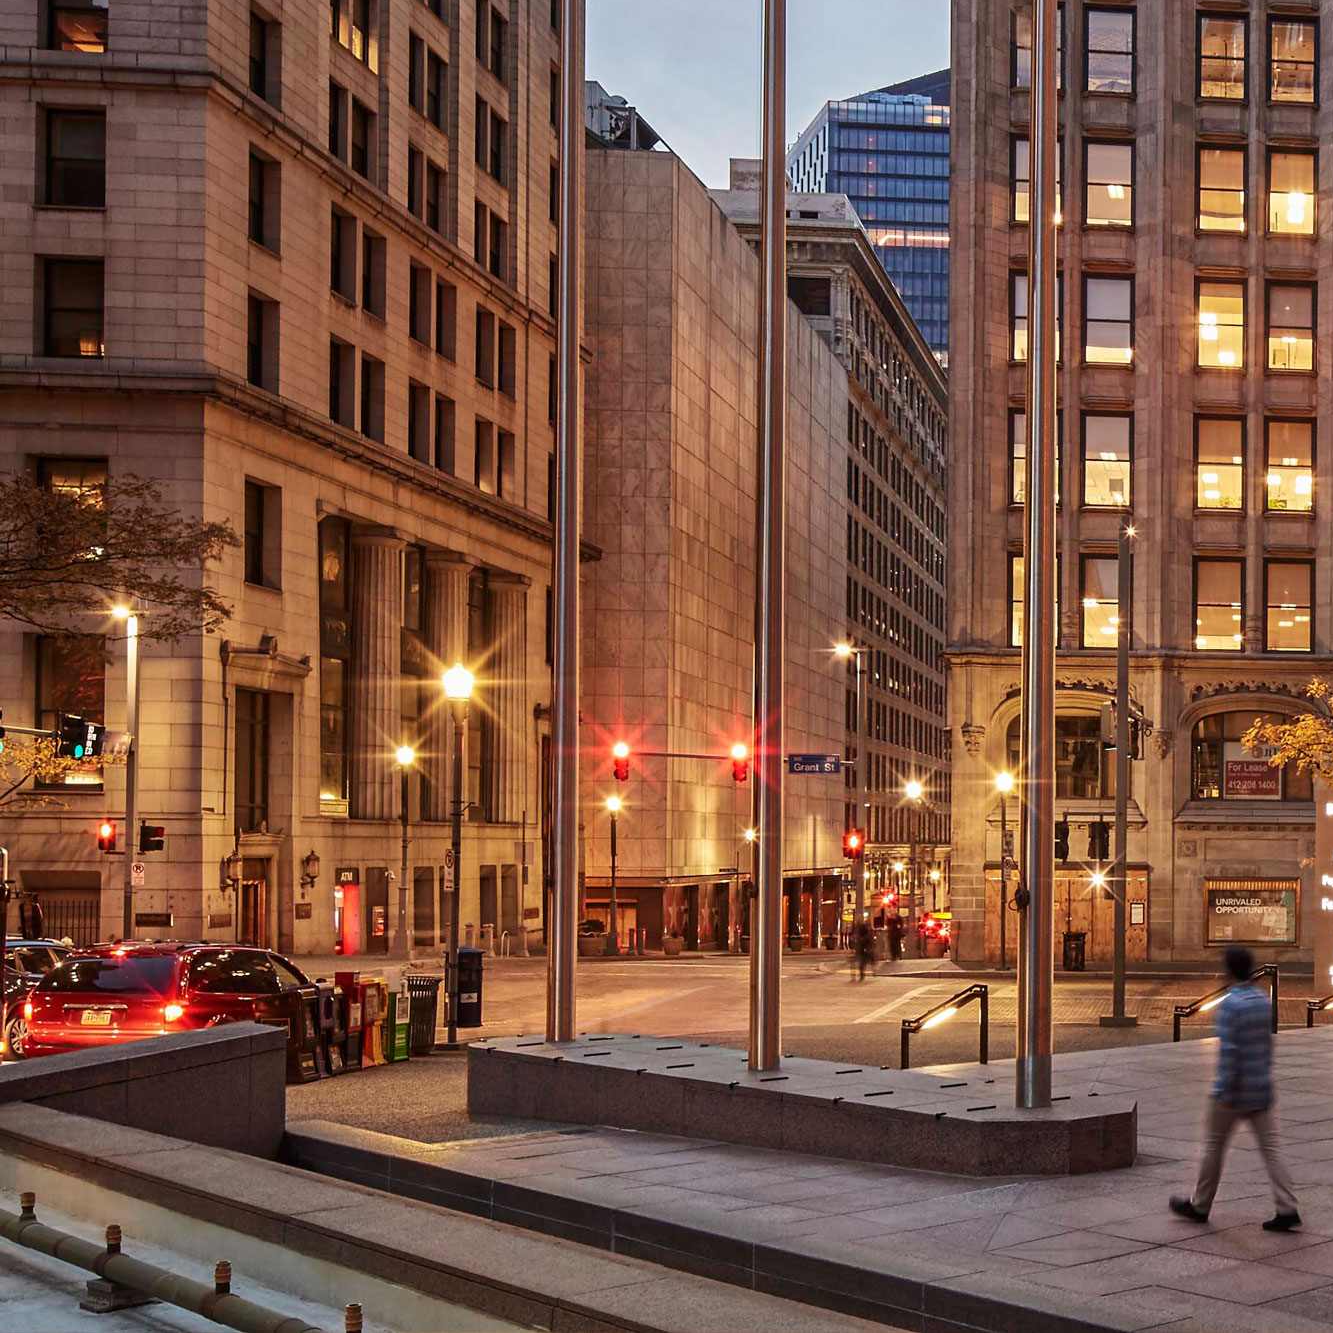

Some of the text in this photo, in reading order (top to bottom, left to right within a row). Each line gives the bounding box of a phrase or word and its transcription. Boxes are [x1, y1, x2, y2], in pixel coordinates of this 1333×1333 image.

[793, 762, 835, 771] Grant St
[1228, 762, 1268, 771] For Lease
[340, 871, 353, 881] ATM
[1215, 898, 1261, 906] UNRIVALED
[1215, 906, 1273, 914] OPPORTUNITY
